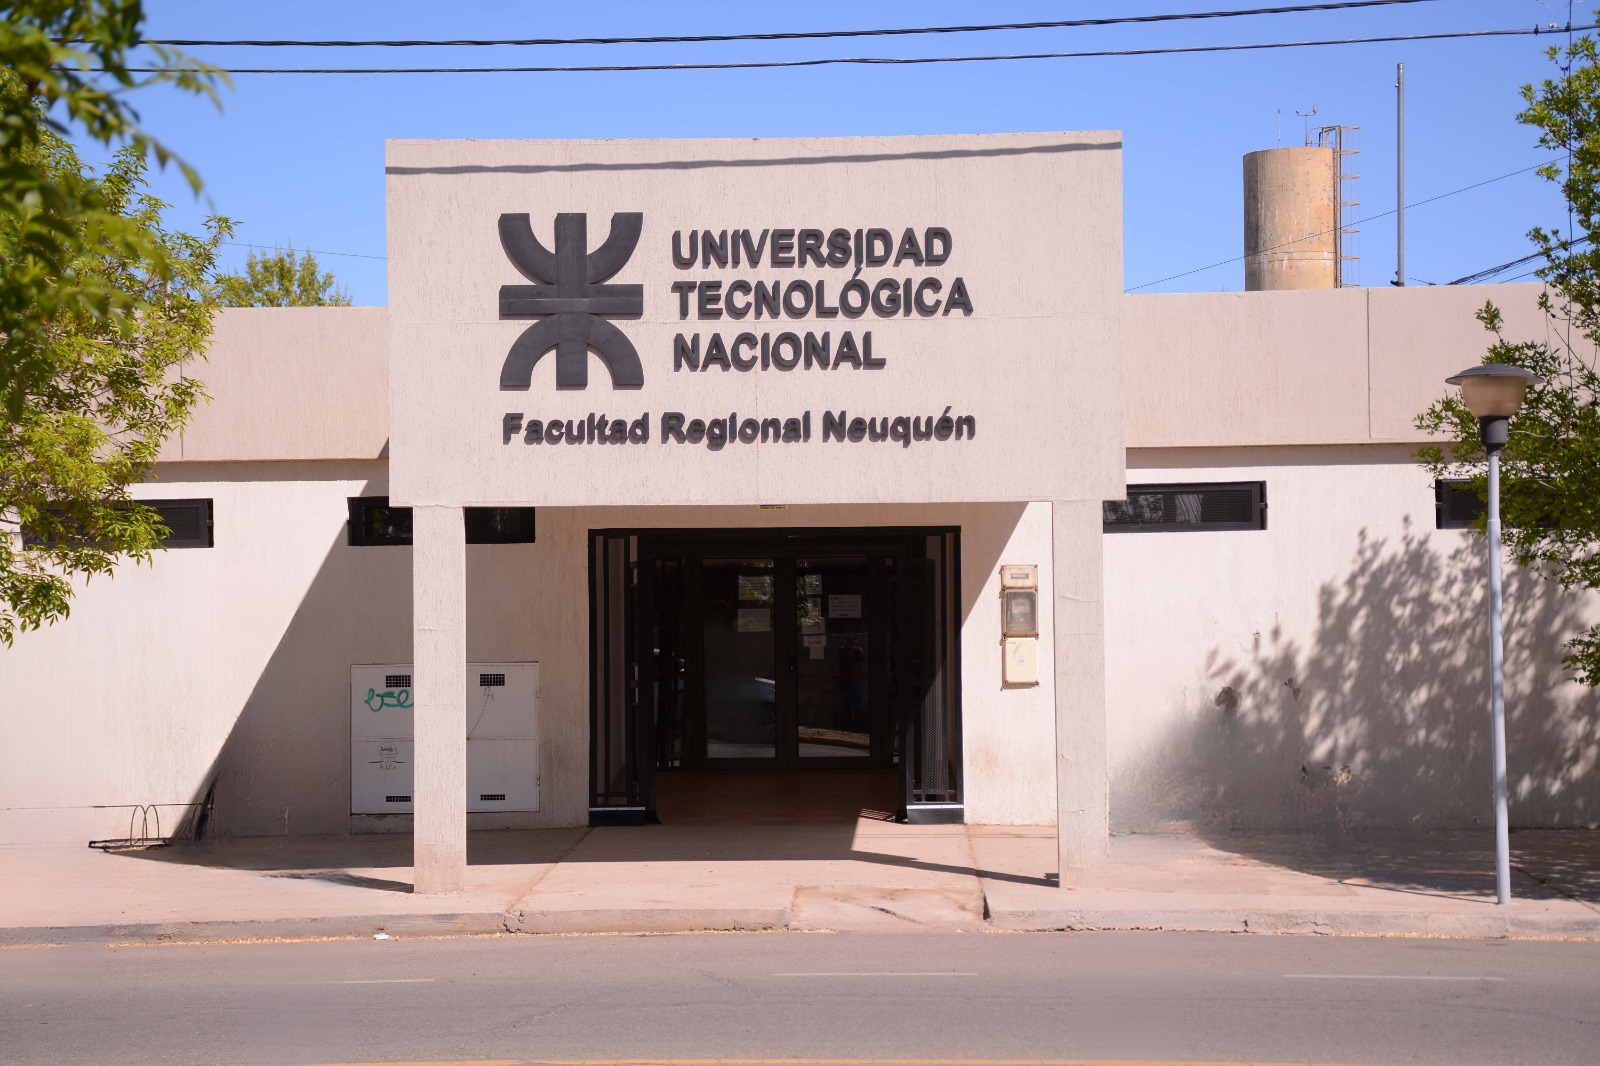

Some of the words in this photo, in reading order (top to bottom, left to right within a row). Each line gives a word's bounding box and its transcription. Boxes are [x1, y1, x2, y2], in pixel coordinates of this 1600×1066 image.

[672, 227, 952, 270] UNIVERSIDAD
[671, 268, 973, 320] TECNOLÓGICA
[673, 331, 886, 372] NACIONAL
[503, 412, 649, 446] Facultad
[661, 411, 811, 451] Regional
[823, 406, 976, 448] Neuquén
